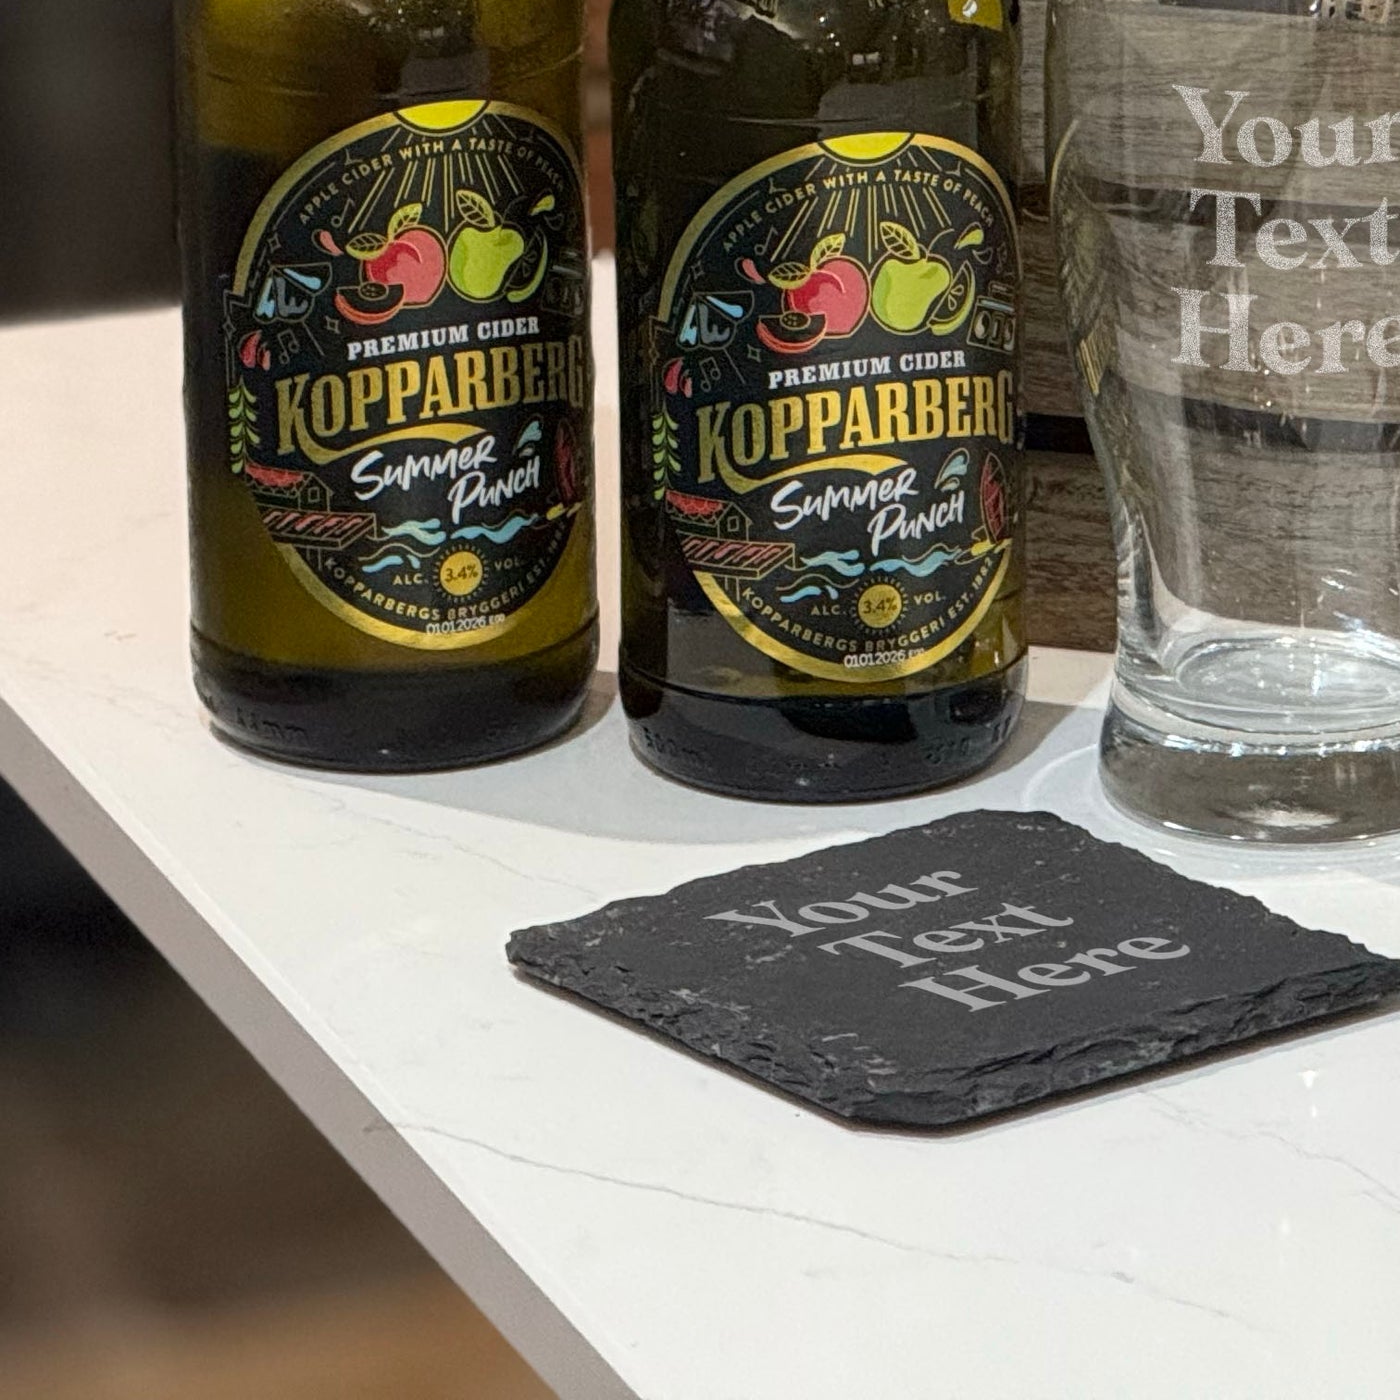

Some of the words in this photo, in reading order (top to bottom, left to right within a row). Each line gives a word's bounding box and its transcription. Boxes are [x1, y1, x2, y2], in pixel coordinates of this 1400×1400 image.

[299, 184, 341, 225] APPLE
[341, 154, 393, 185] CIDER
[399, 141, 445, 161] WITH
[451, 138, 463, 151] A
[469, 137, 514, 155] TASTE
[516, 145, 535, 160] OF
[721, 209, 764, 252] APPLE
[764, 182, 818, 214] CIDER
[822, 170, 869, 190] WITH
[875, 168, 888, 182] A
[893, 168, 939, 188] TASTE
[942, 178, 961, 195] OF
[962, 189, 995, 229] PEACH
[1189, 188, 1400, 271] Text
[347, 324, 470, 361] PREMIUM
[477, 316, 540, 338] CIDER
[768, 354, 892, 390] PREMIUM
[899, 349, 967, 372] CIDER
[274, 335, 585, 465] KOPPARBERG
[694, 369, 1014, 495] KOPPARBERG
[324, 557, 442, 621] KOPPARBERGS
[446, 585, 526, 621] BRYGGERI
[443, 563, 480, 584] 3.4%
[862, 597, 899, 615] 3.4%
[741, 586, 858, 653] KOPPARBERGS
[864, 615, 946, 653] BRYGGERI
[702, 870, 978, 938] Your
[817, 902, 1074, 969] Text
[898, 936, 1191, 1012] Here
